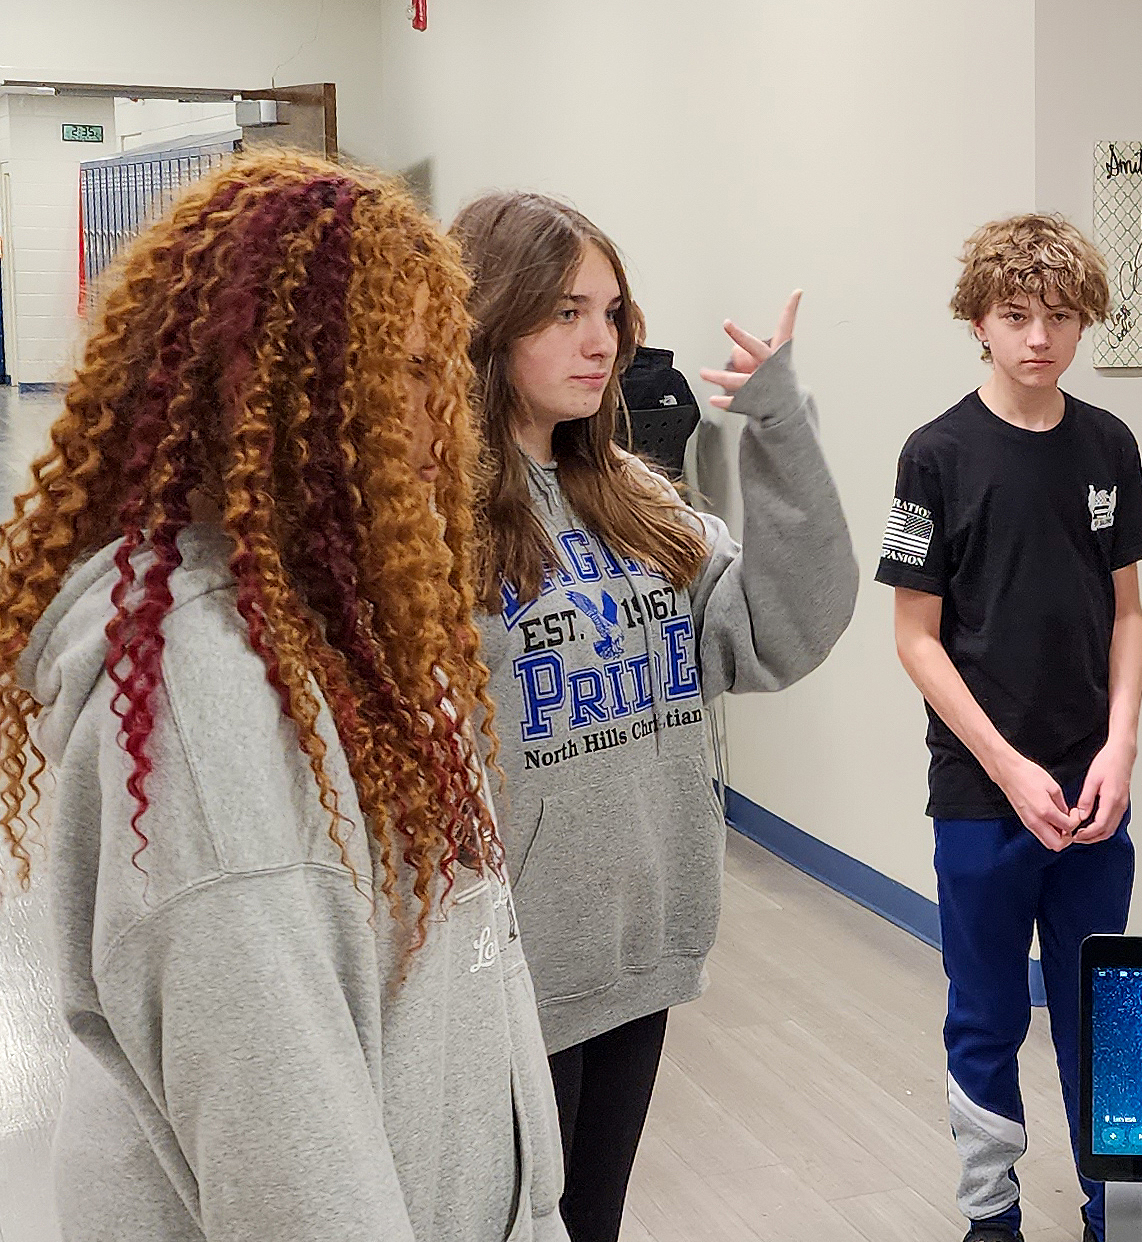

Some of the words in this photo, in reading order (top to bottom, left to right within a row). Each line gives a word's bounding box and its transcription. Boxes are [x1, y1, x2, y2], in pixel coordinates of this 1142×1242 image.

[519, 609, 586, 653] EST.
[620, 587, 678, 629] 1967
[524, 738, 580, 770] North
[583, 729, 628, 754] Hills
[631, 707, 703, 740] Chritian
